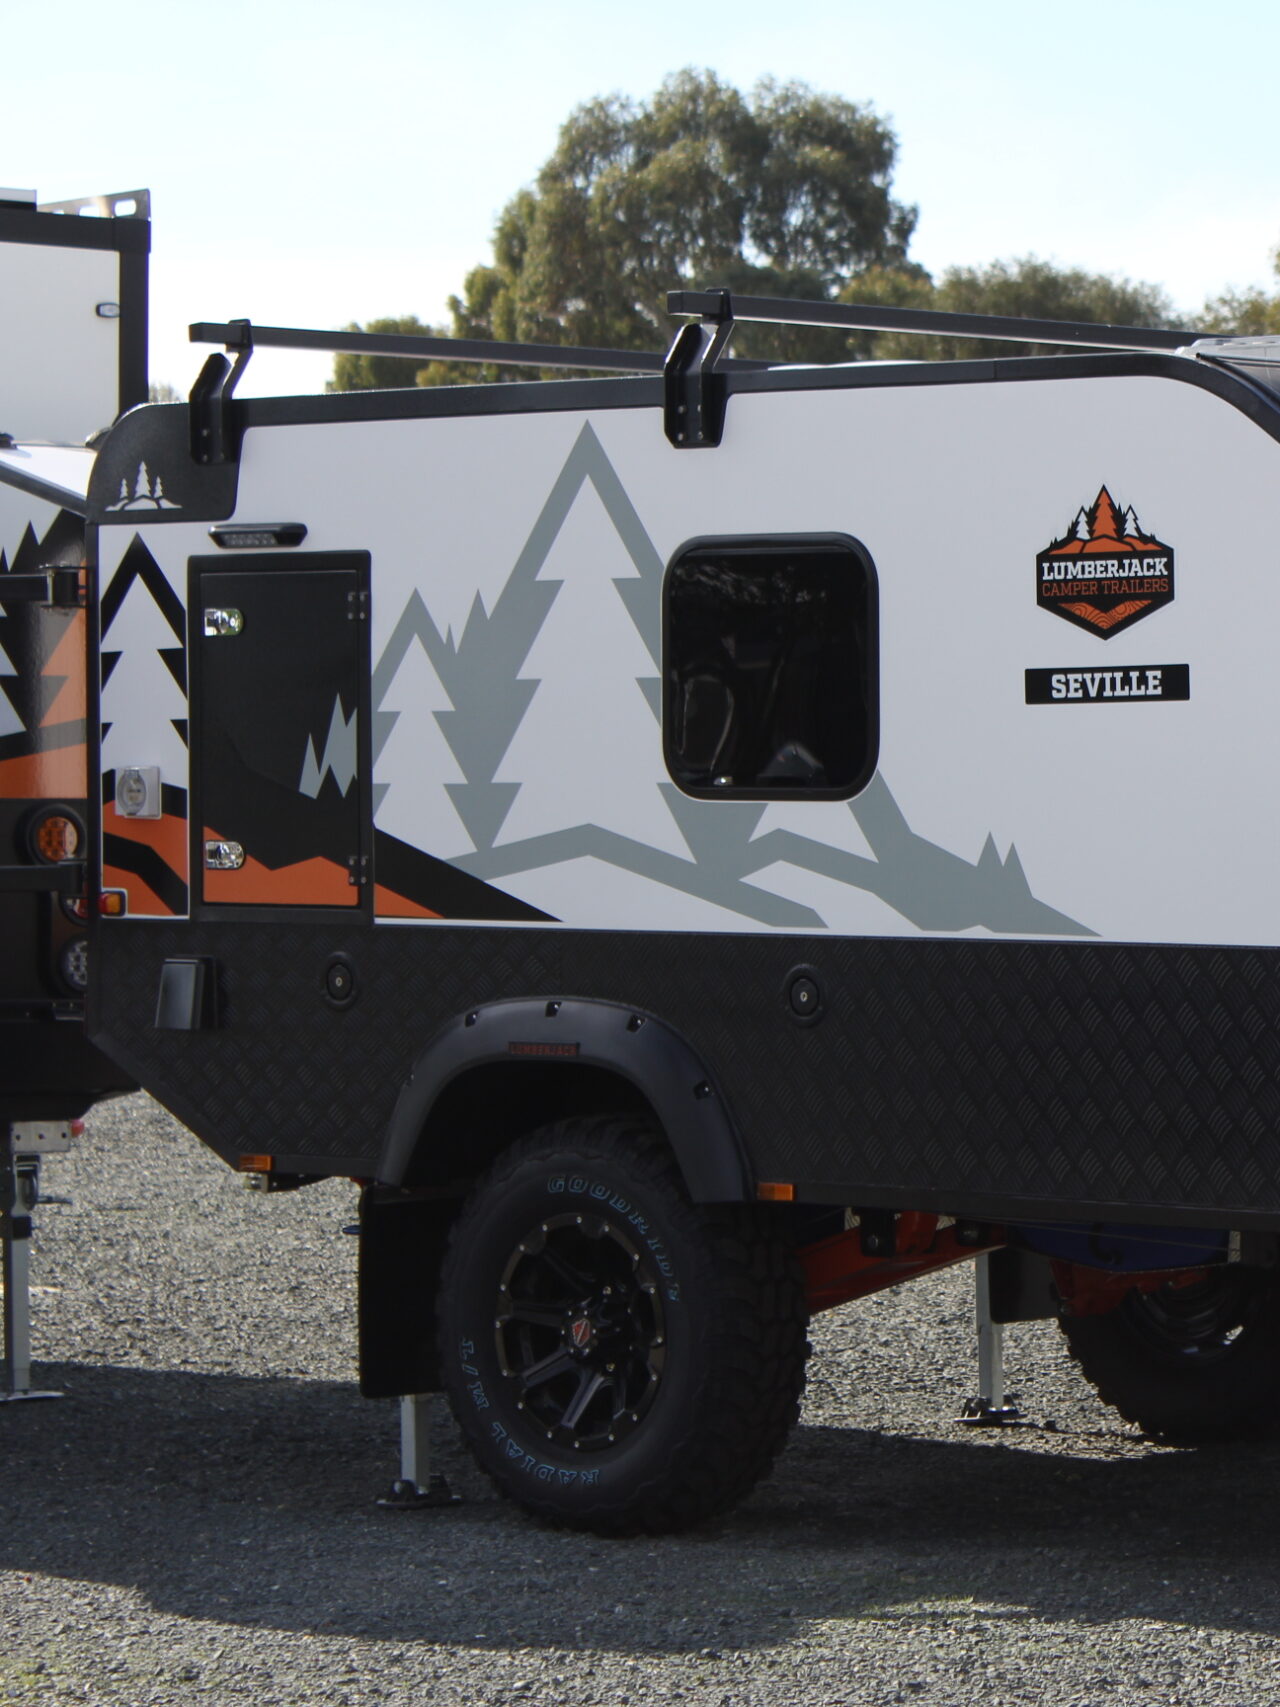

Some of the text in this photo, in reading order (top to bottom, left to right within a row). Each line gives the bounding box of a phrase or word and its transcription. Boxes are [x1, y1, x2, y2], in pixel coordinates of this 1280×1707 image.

[1042, 557, 1169, 580] LUMBERJACK
[1042, 578, 1169, 597] CAMPER TRAILERS
[1051, 670, 1162, 699] SEVILLE
[547, 1175, 680, 1302] GOODRIDE
[489, 1420, 600, 1485] RADIAL
